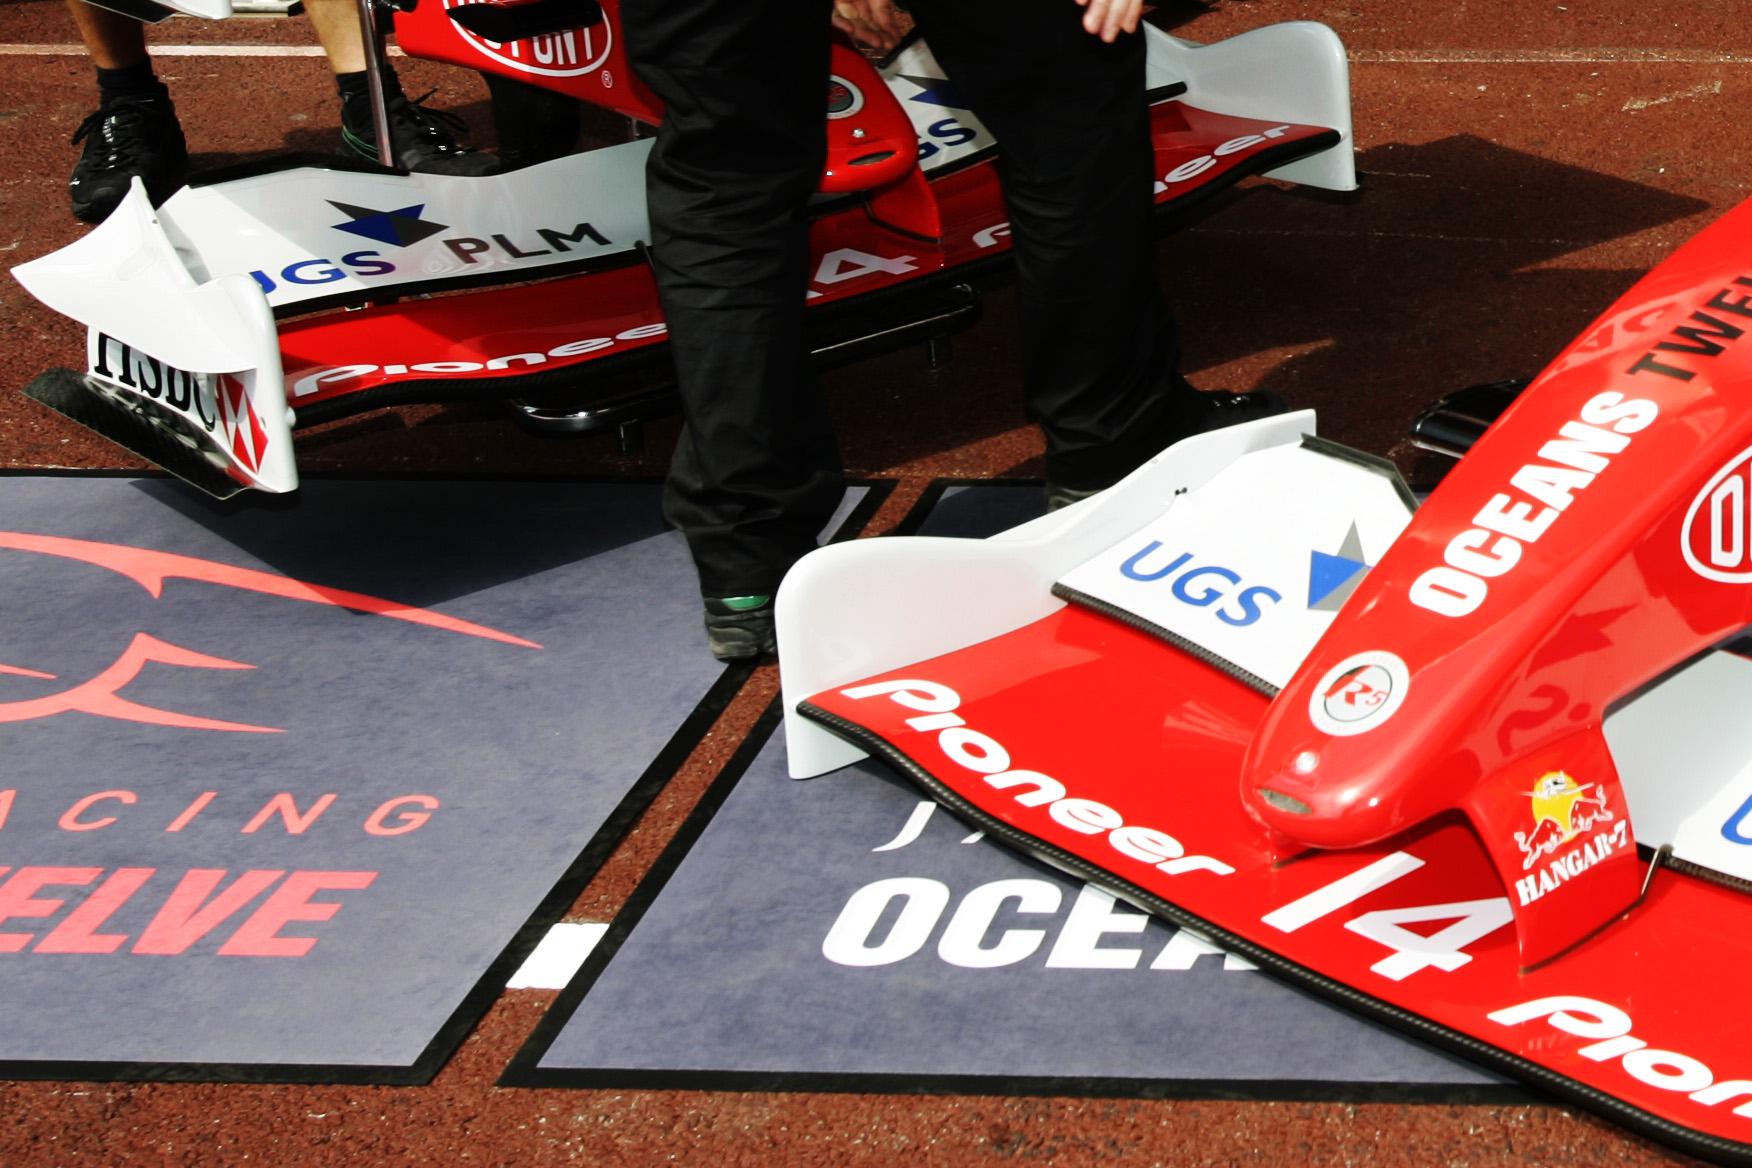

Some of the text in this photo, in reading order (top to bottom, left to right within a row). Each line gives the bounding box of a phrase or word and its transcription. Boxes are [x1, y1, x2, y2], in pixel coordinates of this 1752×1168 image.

[440, 222, 614, 265] PLM
[293, 321, 668, 398] Pionee
[1408, 389, 1660, 619] OCEANS
[1117, 540, 1284, 630] UGS
[0, 789, 440, 836] CING
[841, 678, 1236, 877] Pioneer
[1514, 818, 1629, 907] HANGAR-7
[0, 865, 379, 957] ELVE
[1261, 850, 1514, 982] 14
